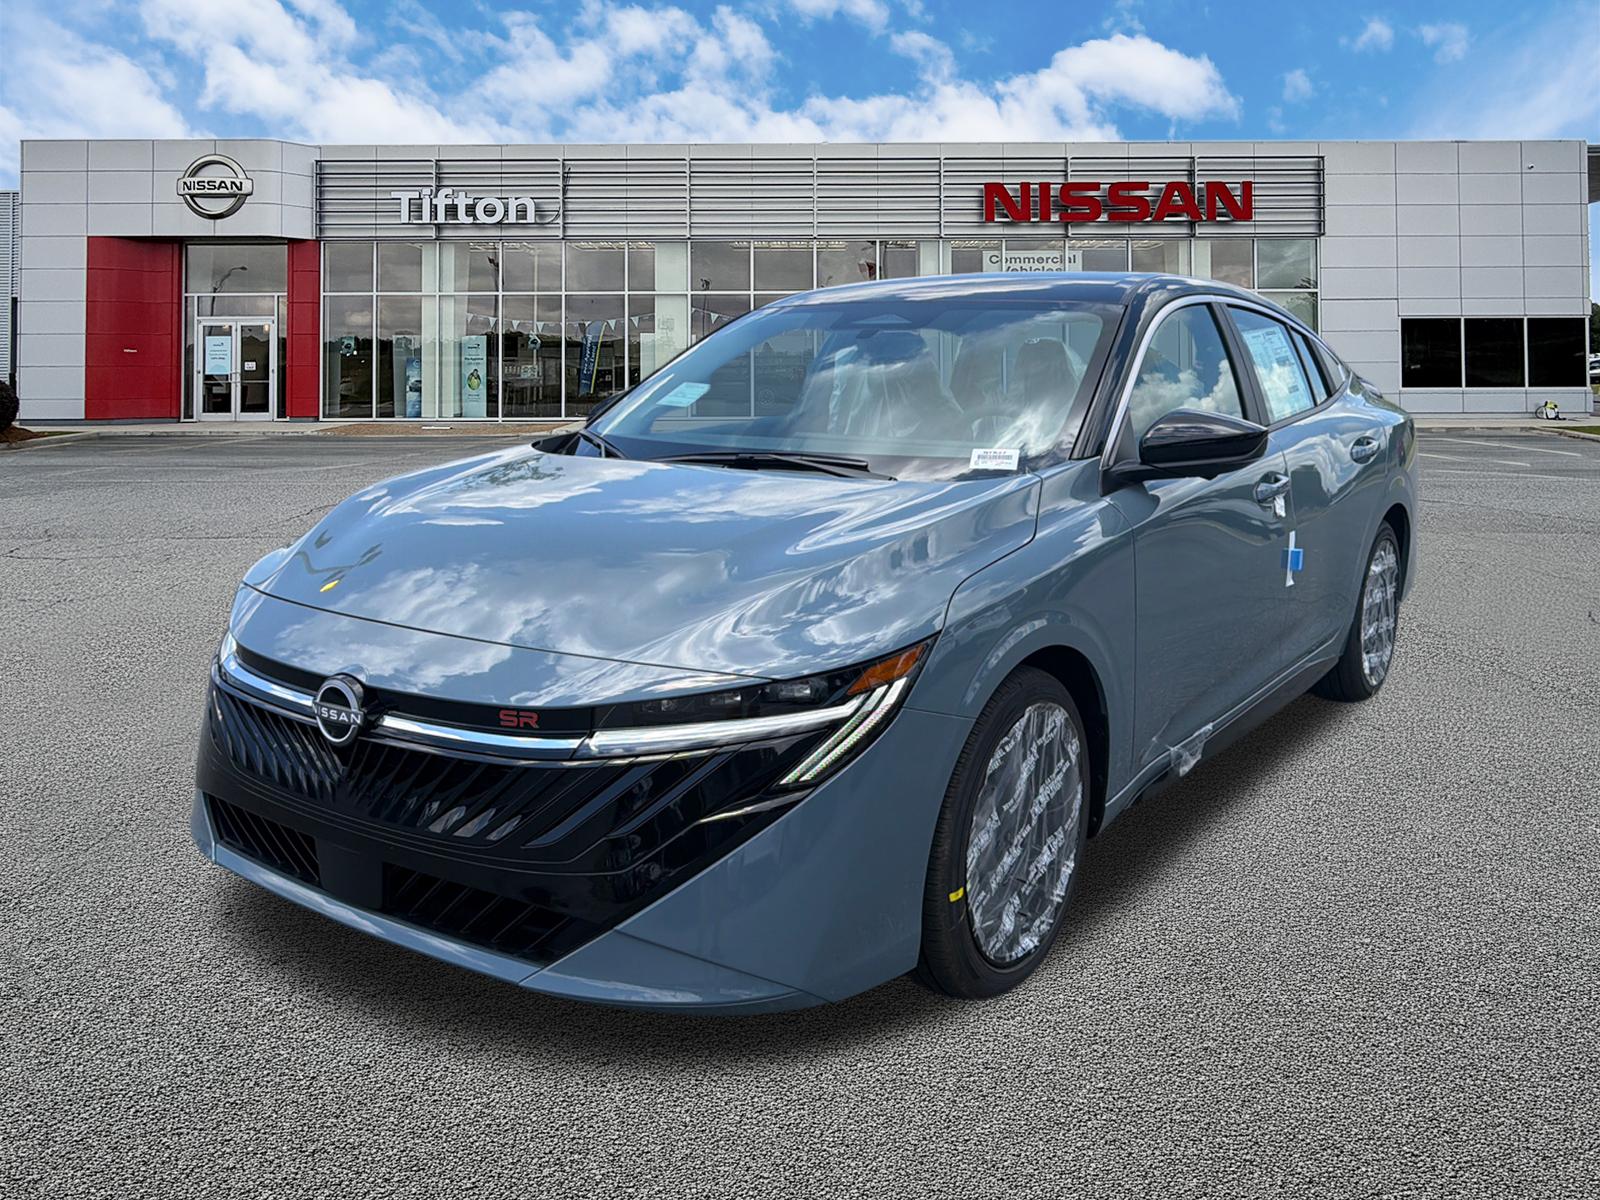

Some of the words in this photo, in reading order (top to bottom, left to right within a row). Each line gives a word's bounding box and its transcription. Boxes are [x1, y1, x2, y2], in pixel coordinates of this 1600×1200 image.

[182, 180, 243, 191] NISSAN
[391, 188, 536, 224] Tifton
[983, 180, 1253, 222] NISSAN
[499, 709, 540, 729] SR
